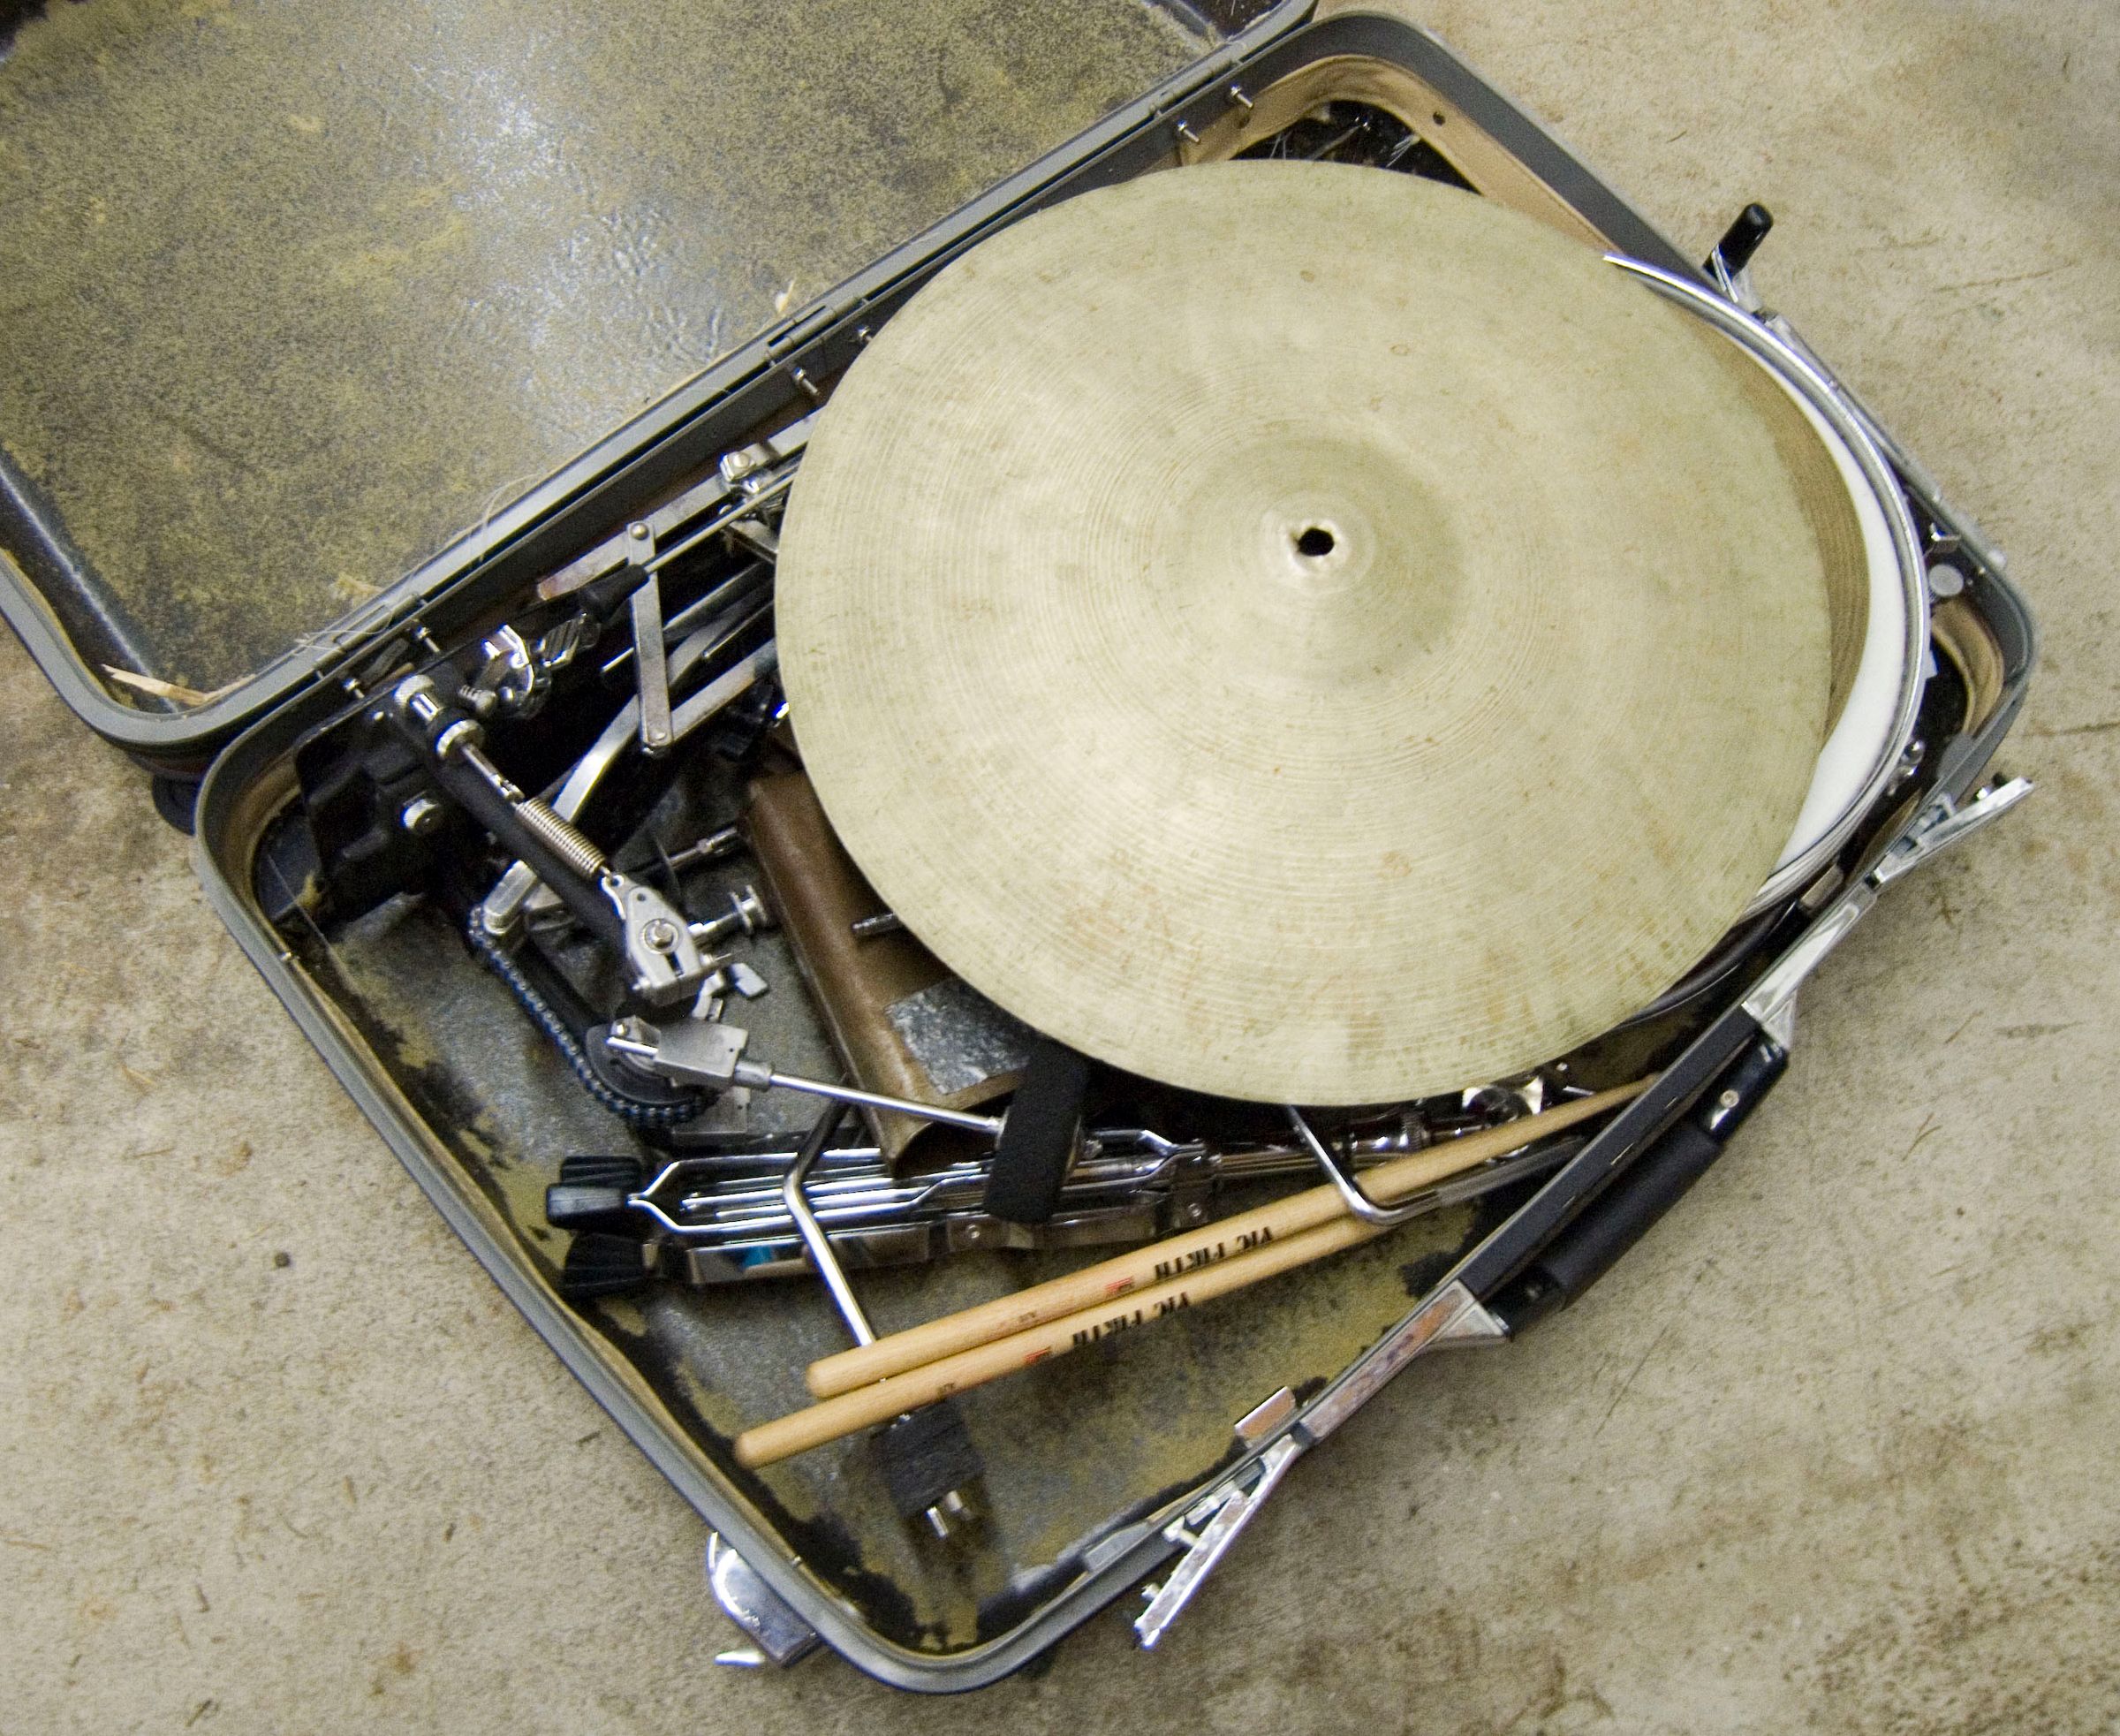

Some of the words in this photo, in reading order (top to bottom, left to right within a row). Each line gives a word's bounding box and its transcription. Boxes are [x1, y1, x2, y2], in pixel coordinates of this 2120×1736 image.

[1237, 1226, 1272, 1249] VIC
[1155, 1242, 1224, 1279] FIRTH
[1154, 1292, 1189, 1316] VIC
